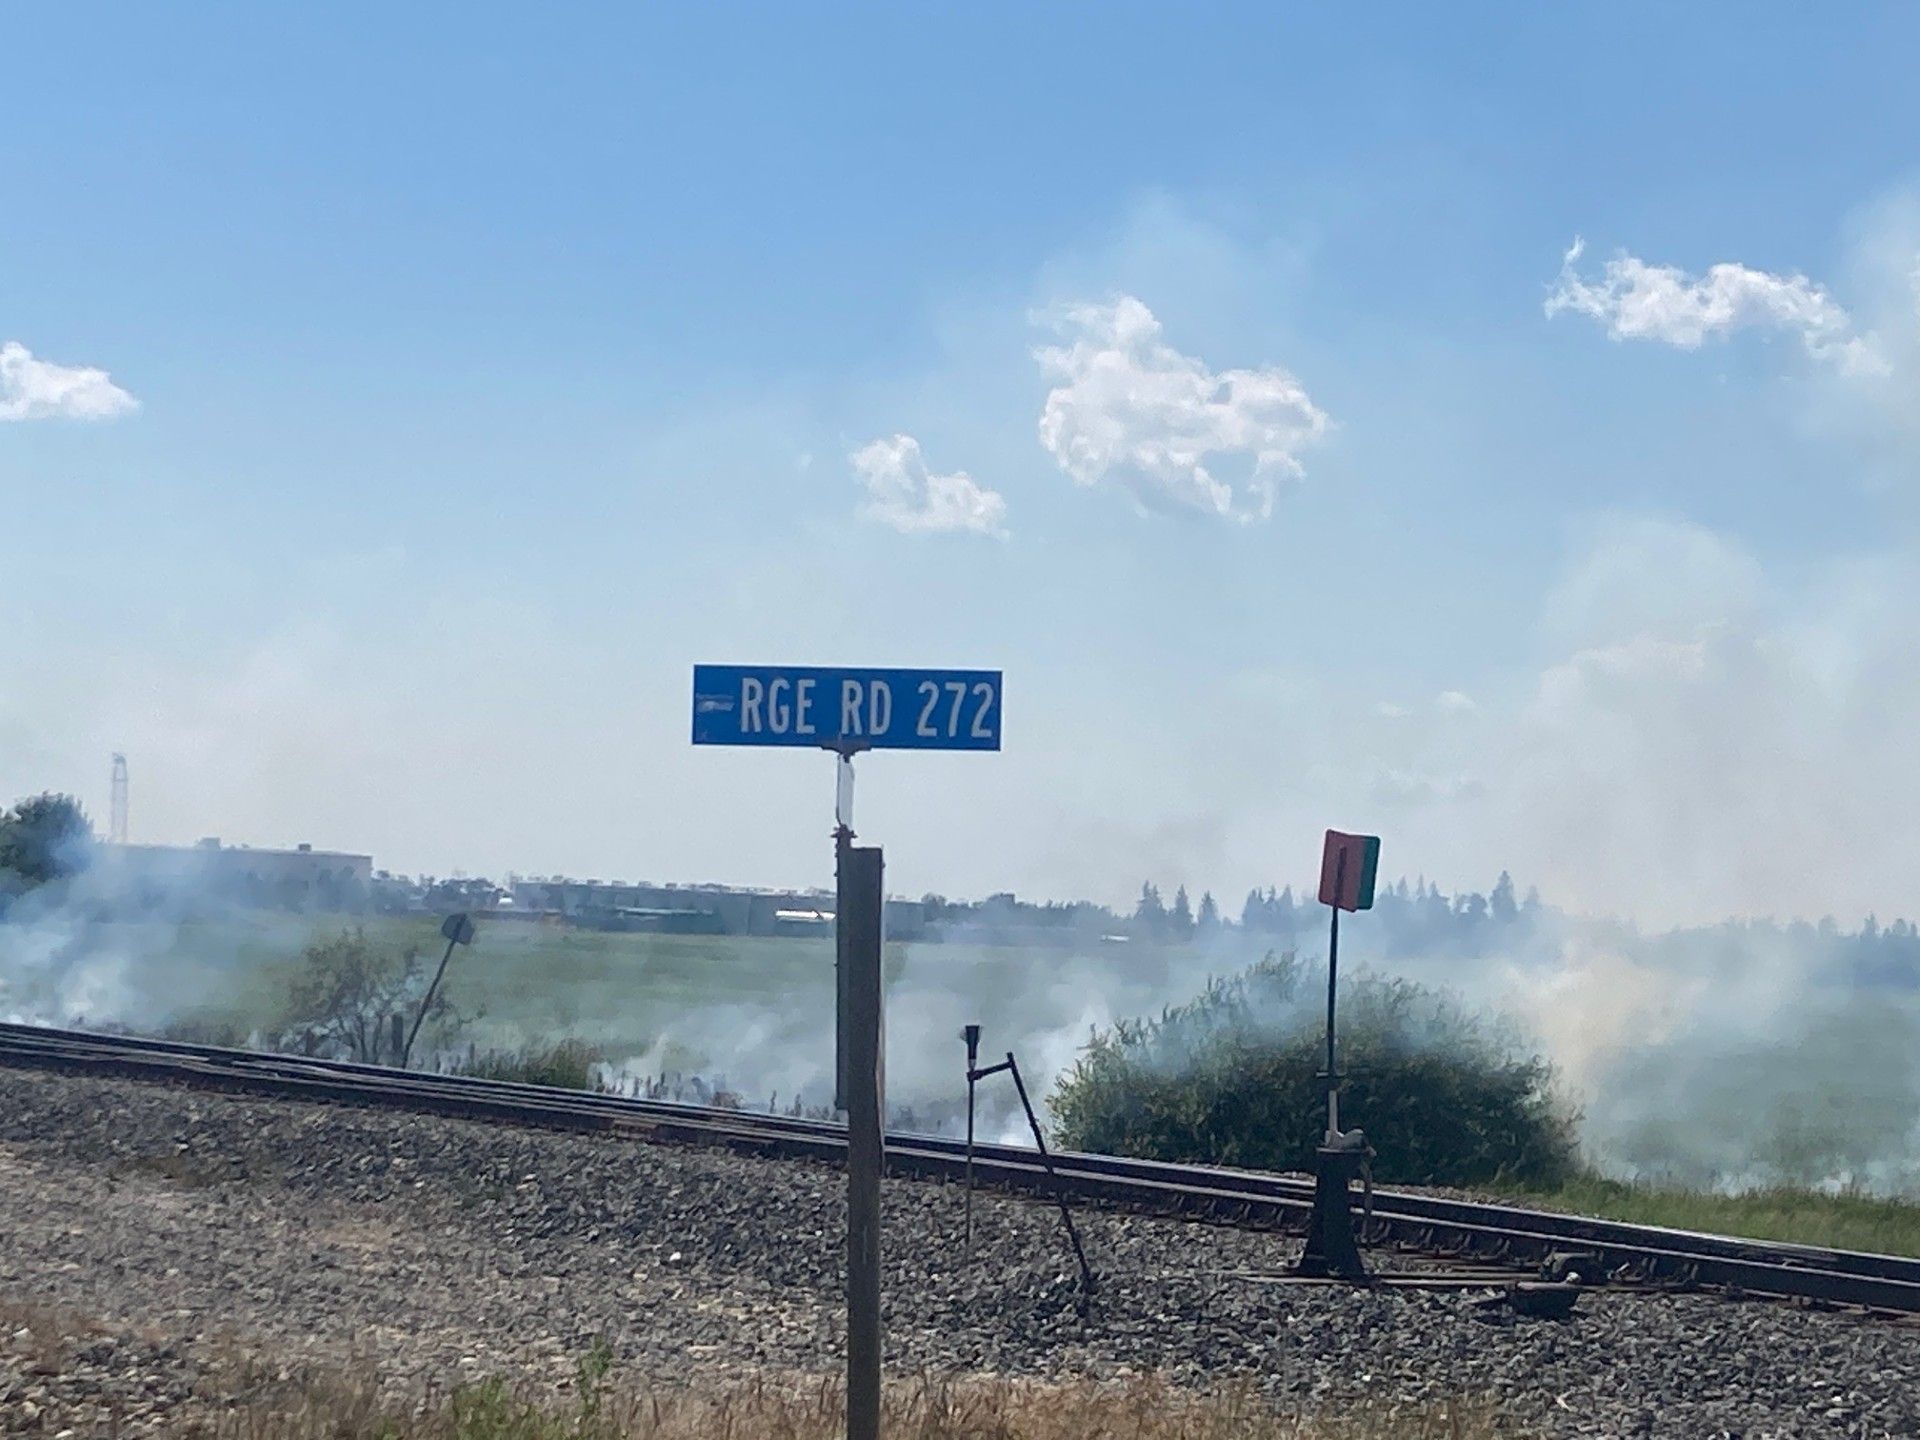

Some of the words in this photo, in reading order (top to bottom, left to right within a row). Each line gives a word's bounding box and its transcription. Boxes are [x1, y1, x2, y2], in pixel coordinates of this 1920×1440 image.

[741, 677, 816, 734] RGE
[841, 679, 892, 736] RD
[916, 680, 994, 738] 272
